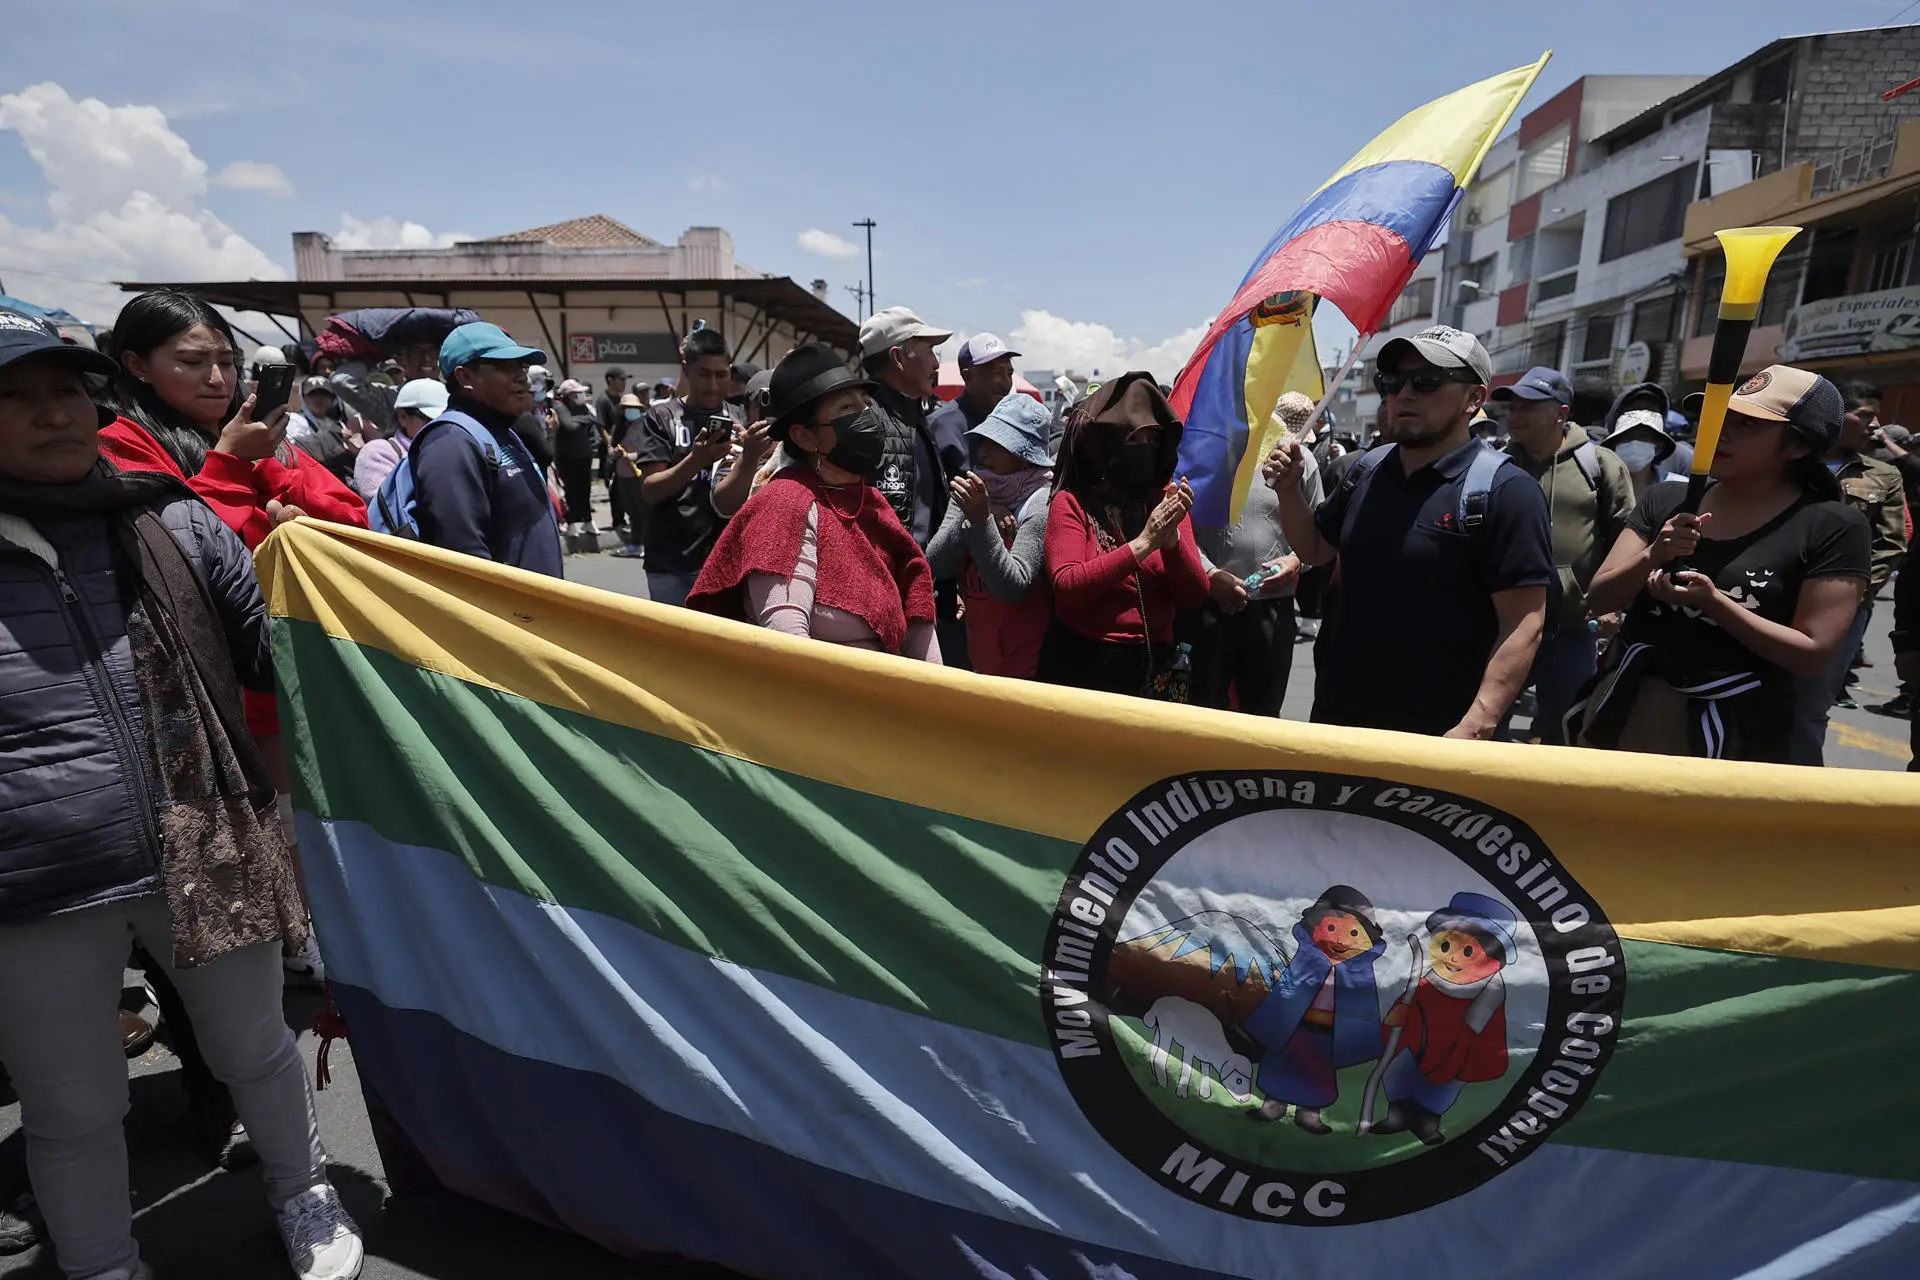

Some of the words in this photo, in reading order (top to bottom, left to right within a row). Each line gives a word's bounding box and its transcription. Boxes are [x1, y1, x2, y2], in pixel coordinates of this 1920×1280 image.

[597, 340, 637, 358] plaza
[675, 425, 691, 448] 10
[1331, 785, 1366, 806] y
[1374, 787, 1590, 933] Campesino
[1048, 836, 1140, 1059] Movimiento
[1565, 946, 1615, 995] de
[1477, 1012, 1613, 1167] Cotopaxi
[1160, 1142, 1346, 1217] MICC
